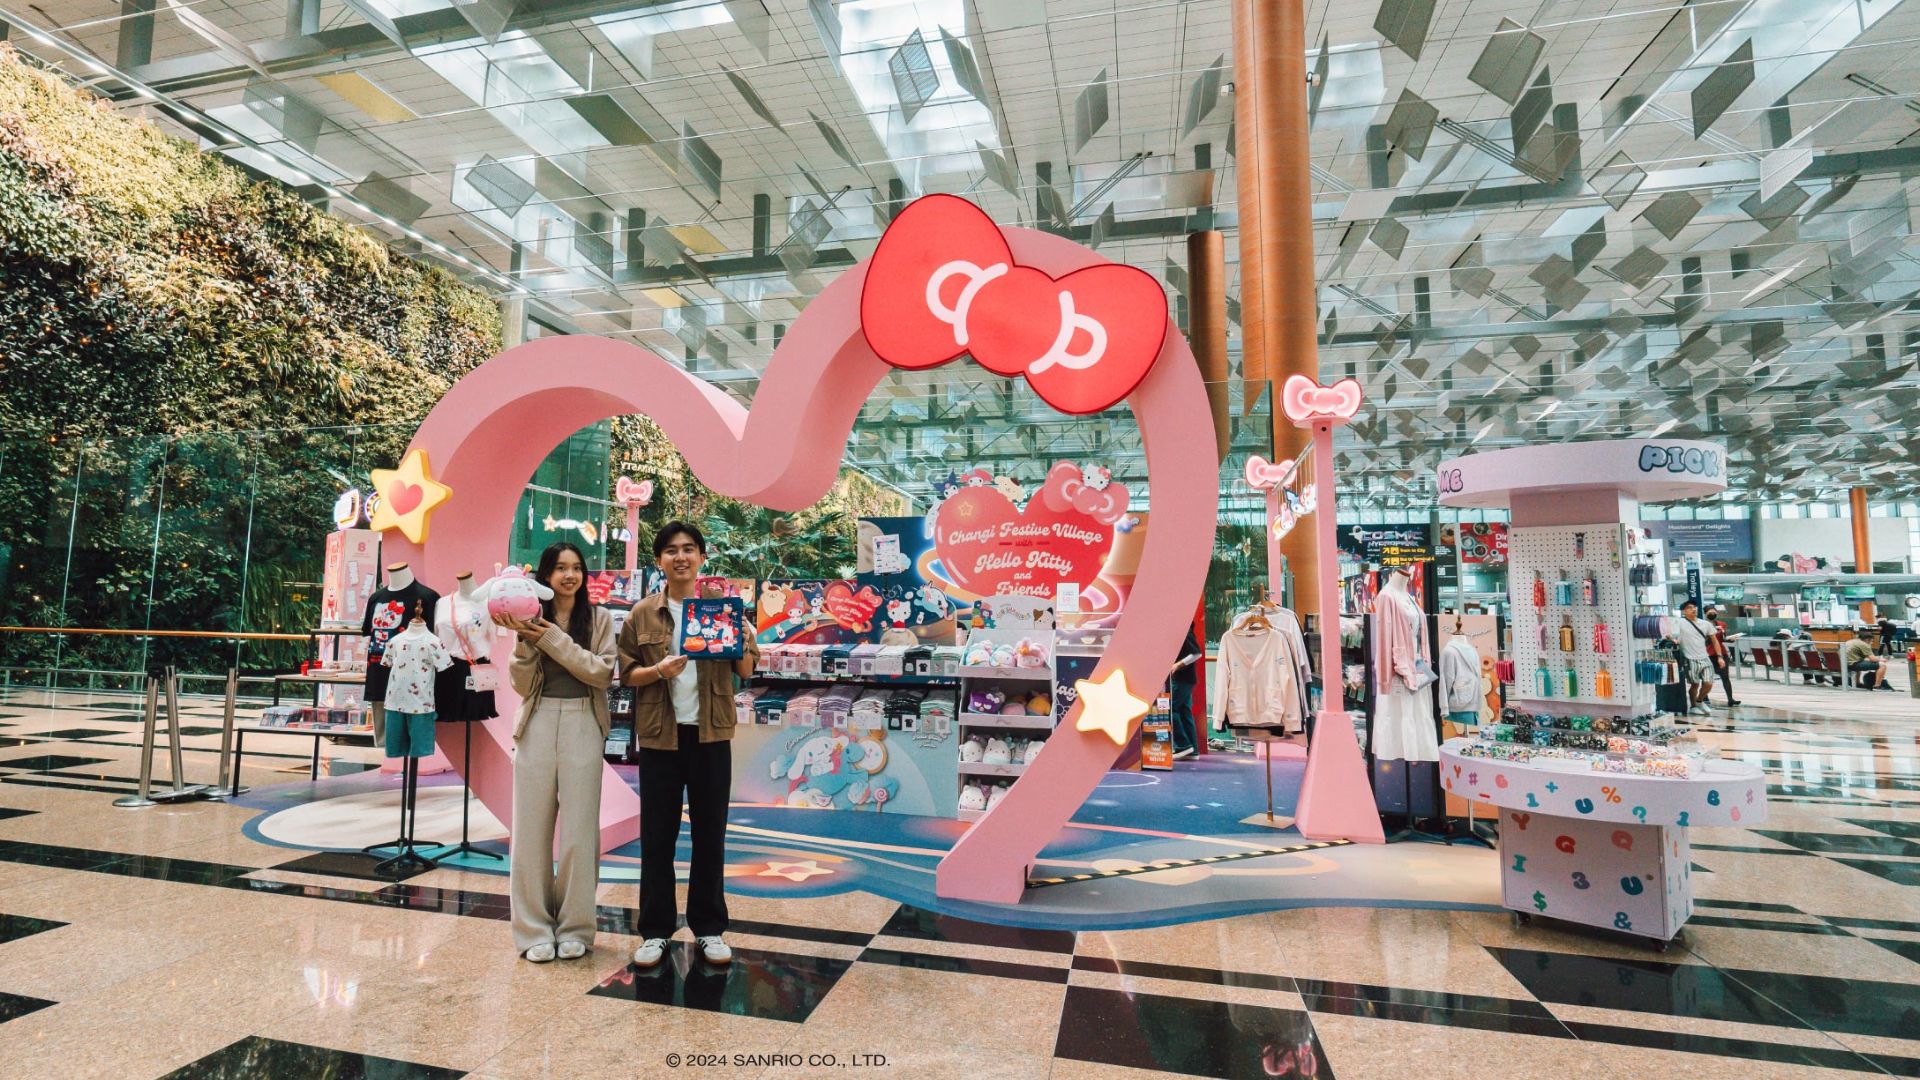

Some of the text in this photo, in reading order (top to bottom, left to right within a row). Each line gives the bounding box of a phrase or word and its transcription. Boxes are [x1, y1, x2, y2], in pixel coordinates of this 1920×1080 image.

[1639, 445, 1718, 477] PICK
[1440, 468, 1464, 493] ME
[949, 522, 1104, 546] Changi Festive Village
[1362, 530, 1424, 540] COSMIC
[974, 551, 1073, 576] Hello Kitty
[1014, 572, 1032, 580] and
[1688, 571, 1698, 598] Trolleys
[995, 581, 1051, 598] Friends
